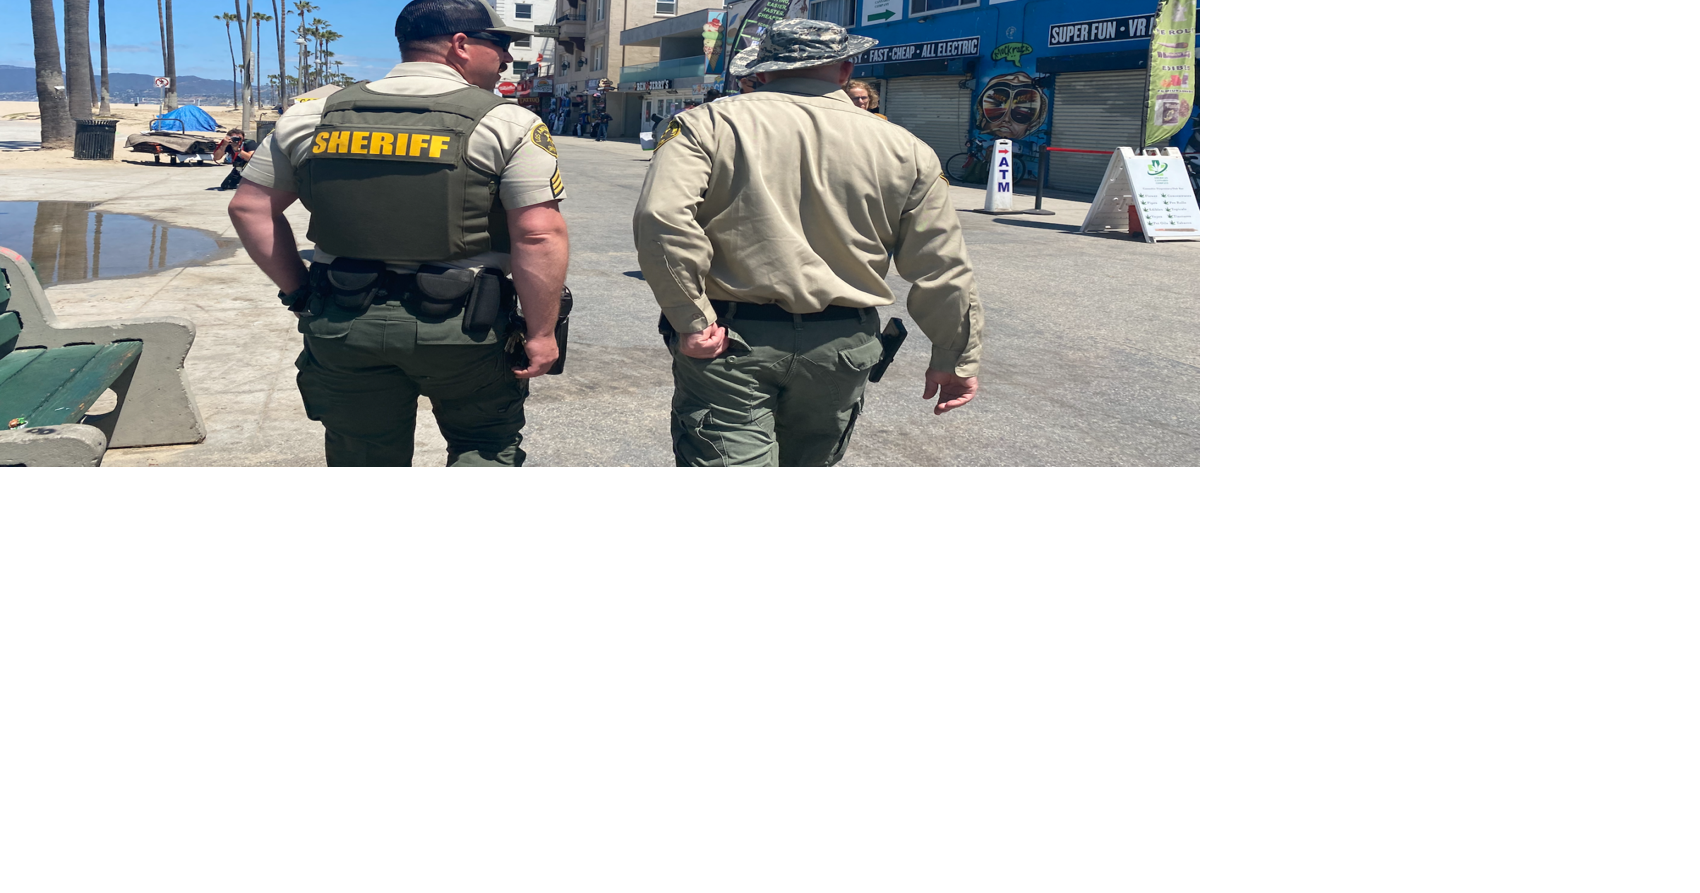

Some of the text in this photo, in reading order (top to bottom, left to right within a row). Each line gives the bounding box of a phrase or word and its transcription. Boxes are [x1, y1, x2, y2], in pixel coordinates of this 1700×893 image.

[1051, 24, 1089, 44] SUPER
[1090, 21, 1117, 40] FUN
[1128, 17, 1147, 37] VR
[869, 48, 889, 62] FAST
[891, 46, 915, 60] CHEAP
[921, 43, 936, 58] ALL
[937, 39, 978, 57] ELECTRIC
[312, 131, 451, 158] SHERIFF
[997, 157, 1011, 193] ATM
